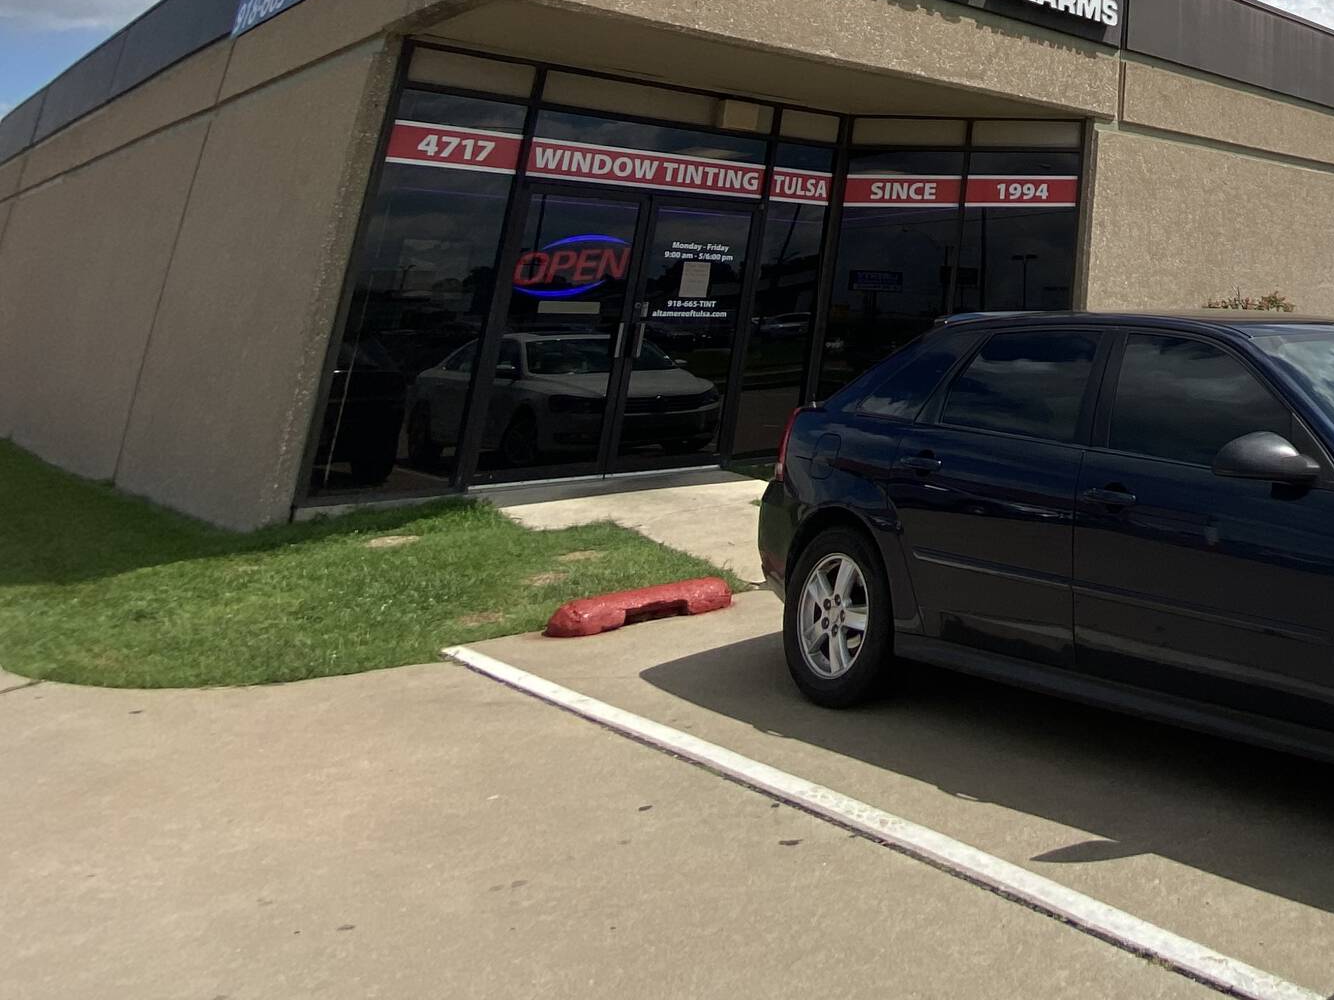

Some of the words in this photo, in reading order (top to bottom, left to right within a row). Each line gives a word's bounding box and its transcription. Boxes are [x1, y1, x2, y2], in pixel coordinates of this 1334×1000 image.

[417, 134, 495, 162] 4717
[534, 147, 659, 180] WINDOW
[663, 162, 760, 191] TINTING
[774, 175, 827, 198] TULSA
[870, 182, 937, 200] SINCE
[996, 183, 1049, 200] 1994
[664, 251, 681, 259] 9:00
[672, 241, 702, 251] Monday
[707, 243, 729, 252] Friday
[513, 247, 632, 287] OPEN
[667, 300, 717, 308] 918-665-TINT
[652, 310, 727, 318] altamereoftulsa.com
